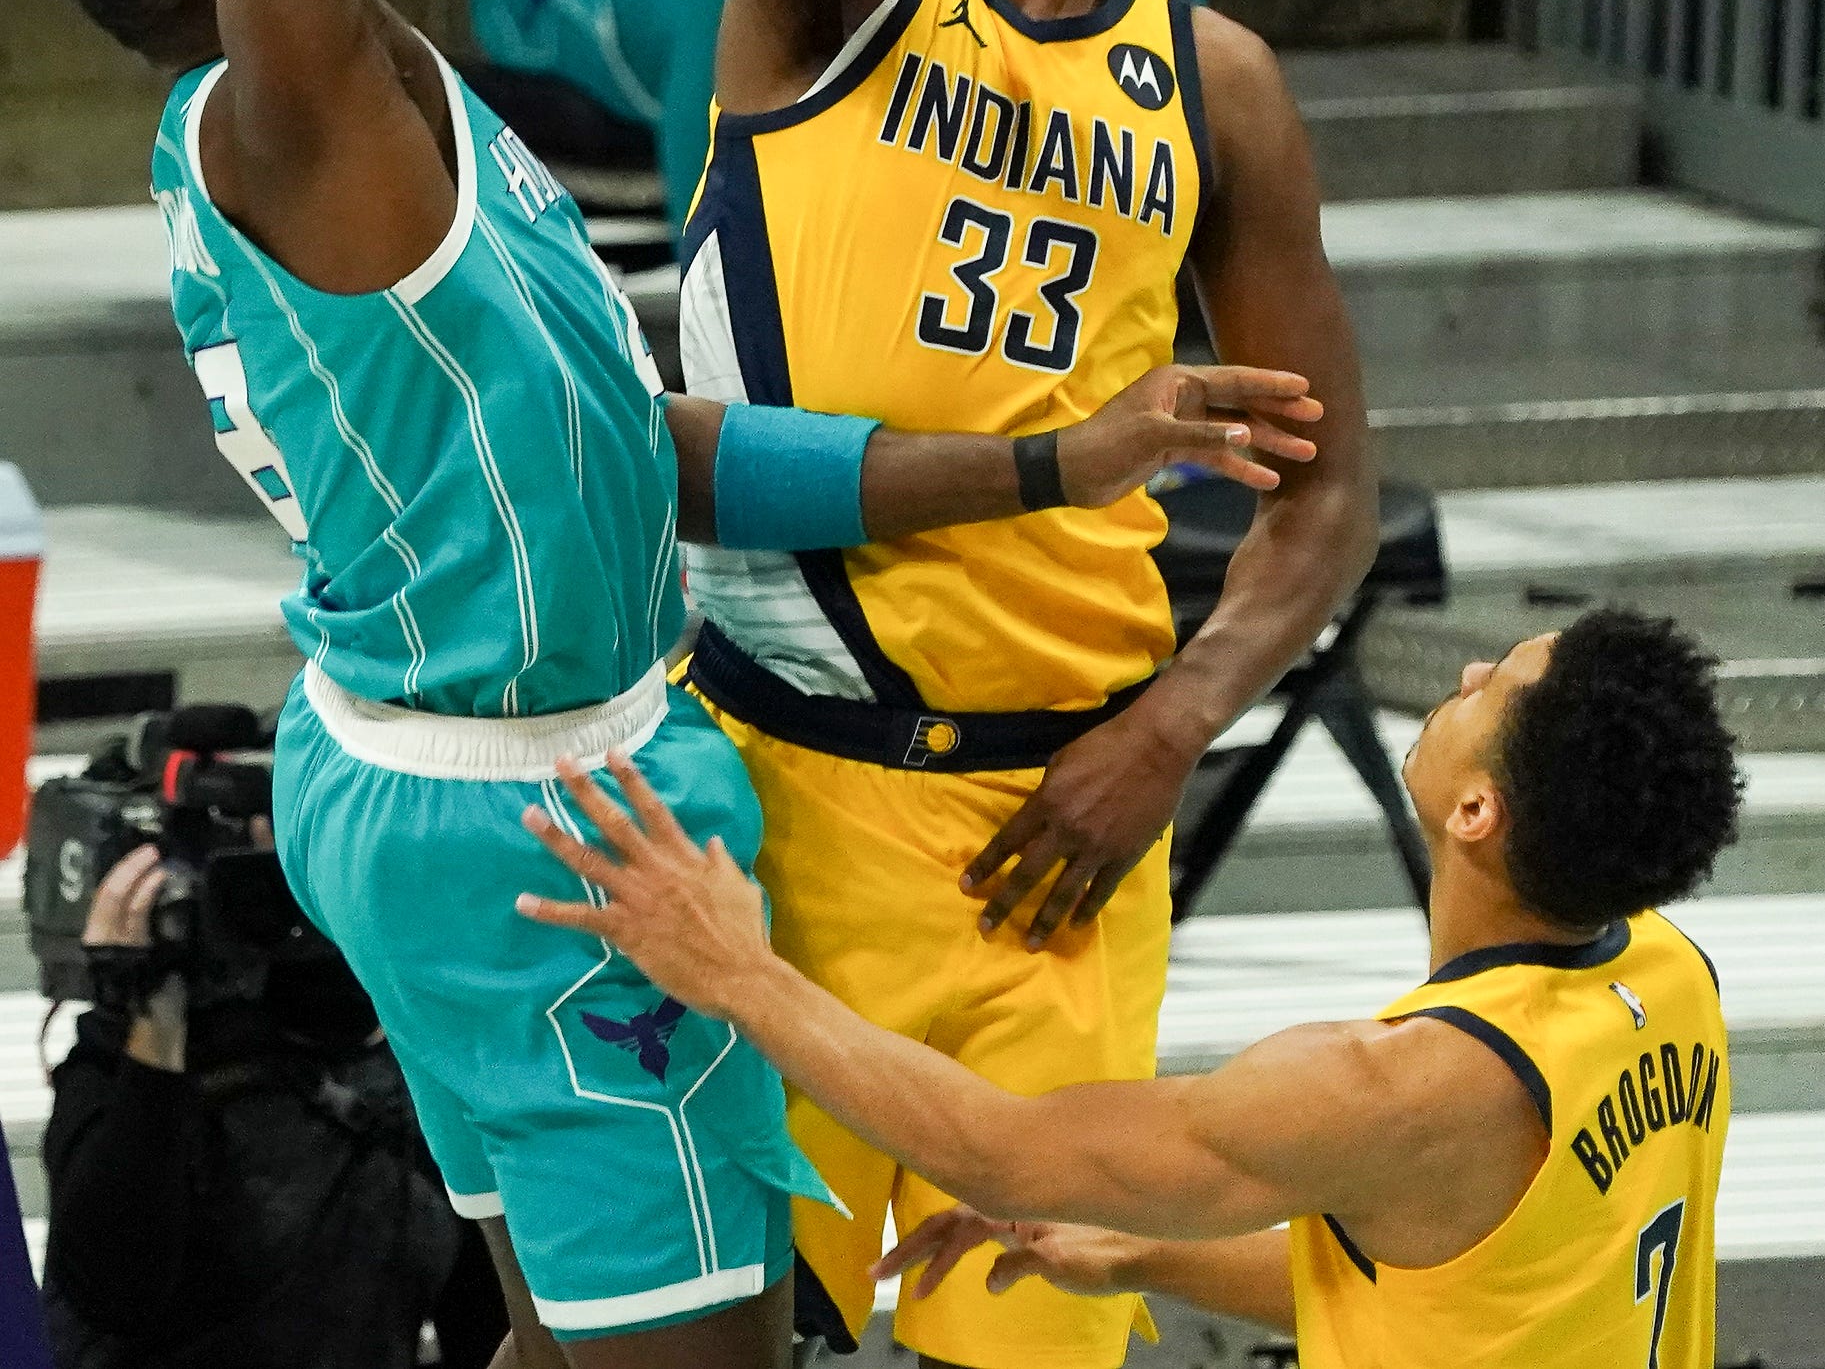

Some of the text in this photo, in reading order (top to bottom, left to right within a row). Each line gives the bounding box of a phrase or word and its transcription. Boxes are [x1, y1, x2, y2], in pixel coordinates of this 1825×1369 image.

[876, 50, 1177, 239] INDIANA
[914, 195, 1101, 377] 33
[1570, 1041, 1720, 1196] BROGDON
[1633, 1195, 1687, 1369] 7
